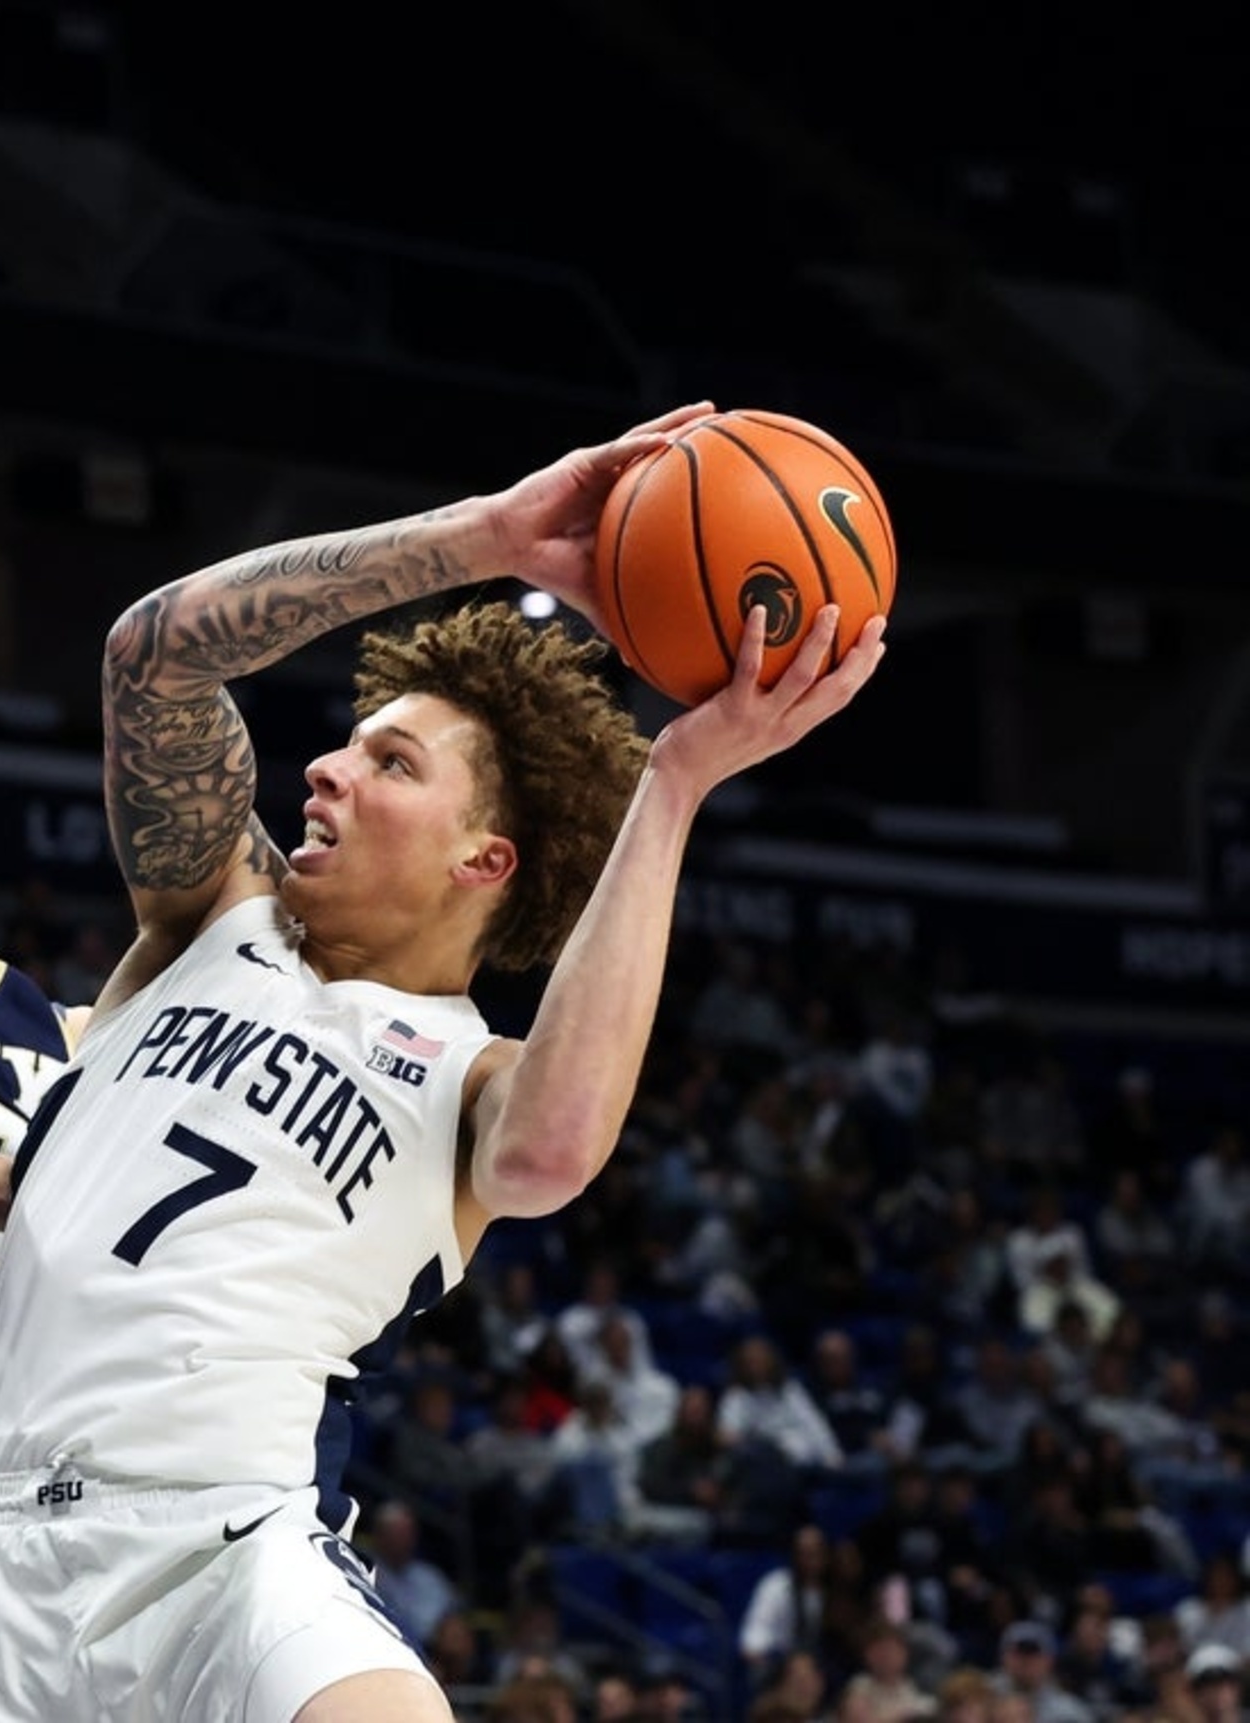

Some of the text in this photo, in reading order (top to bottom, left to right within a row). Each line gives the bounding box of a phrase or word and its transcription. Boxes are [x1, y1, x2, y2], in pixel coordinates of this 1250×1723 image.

[114, 1006, 397, 1226] PENN STATE
[111, 1121, 259, 1268] 7
[37, 1480, 84, 1506] PSU
